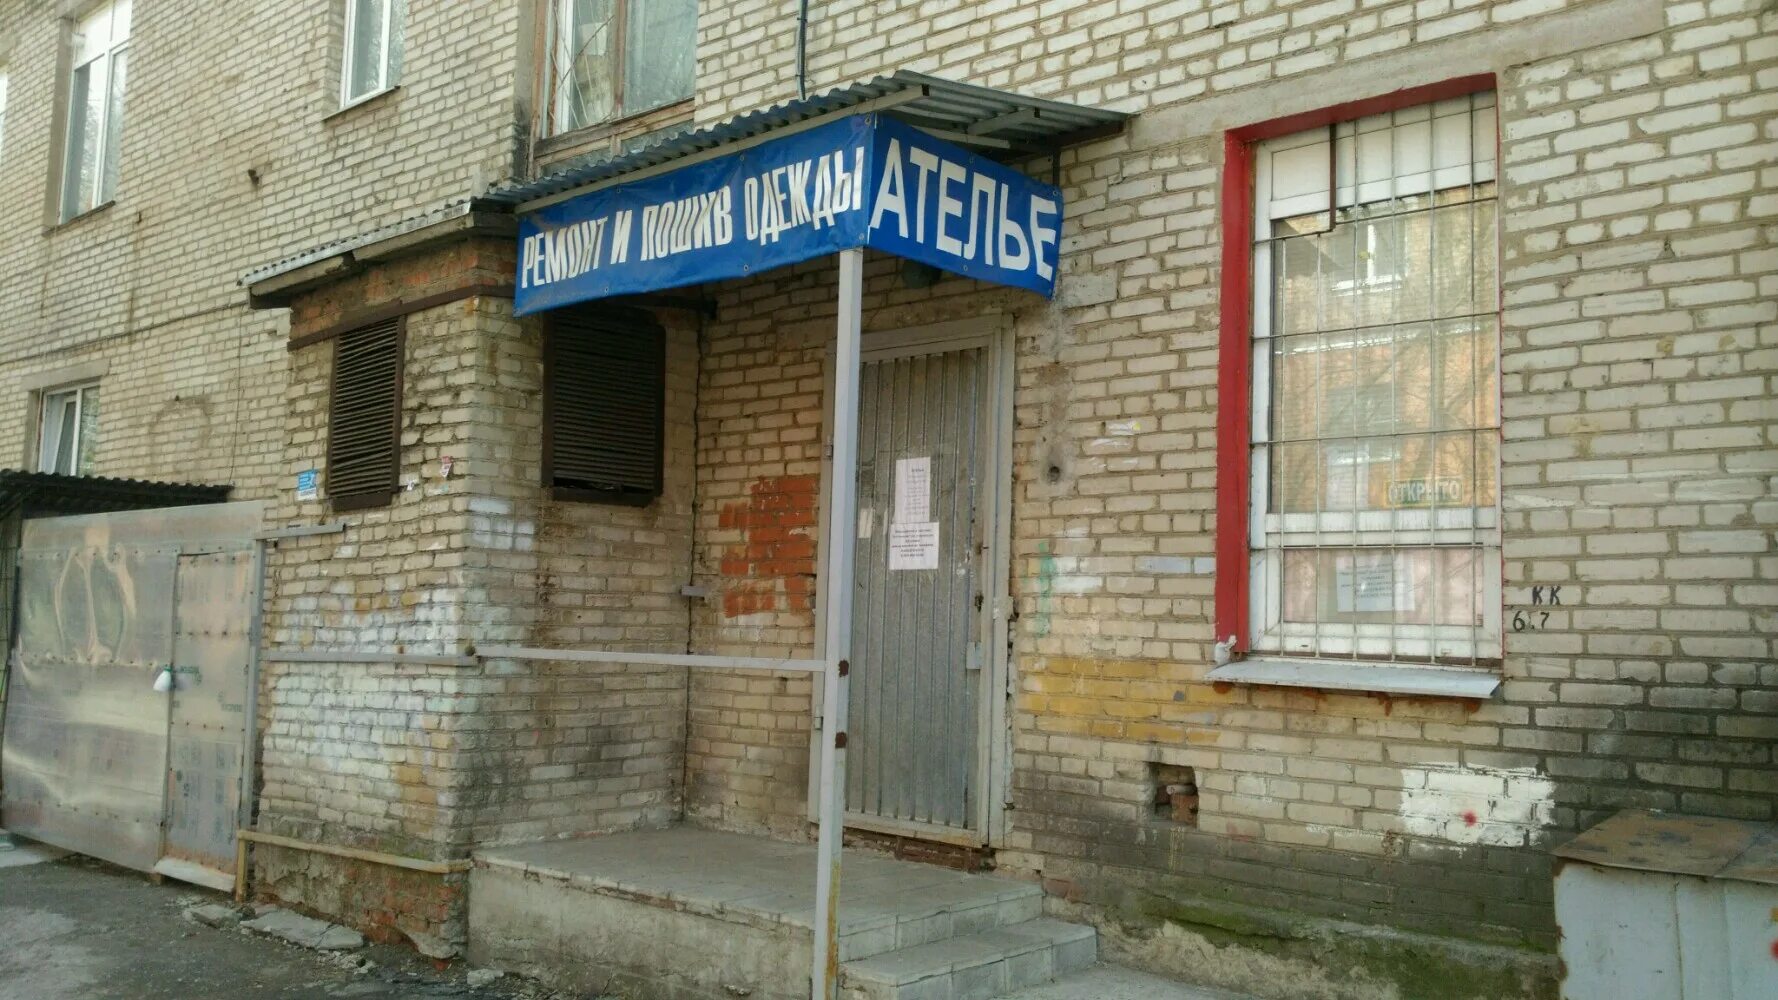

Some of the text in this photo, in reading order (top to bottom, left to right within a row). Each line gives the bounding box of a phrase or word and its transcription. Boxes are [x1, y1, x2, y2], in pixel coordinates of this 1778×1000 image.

[522, 216, 608, 289] РЕМОНТ
[610, 210, 633, 265] И
[744, 146, 865, 246] ОДЕЖДЫ
[869, 137, 1058, 282] АТЕЛЬЕ
